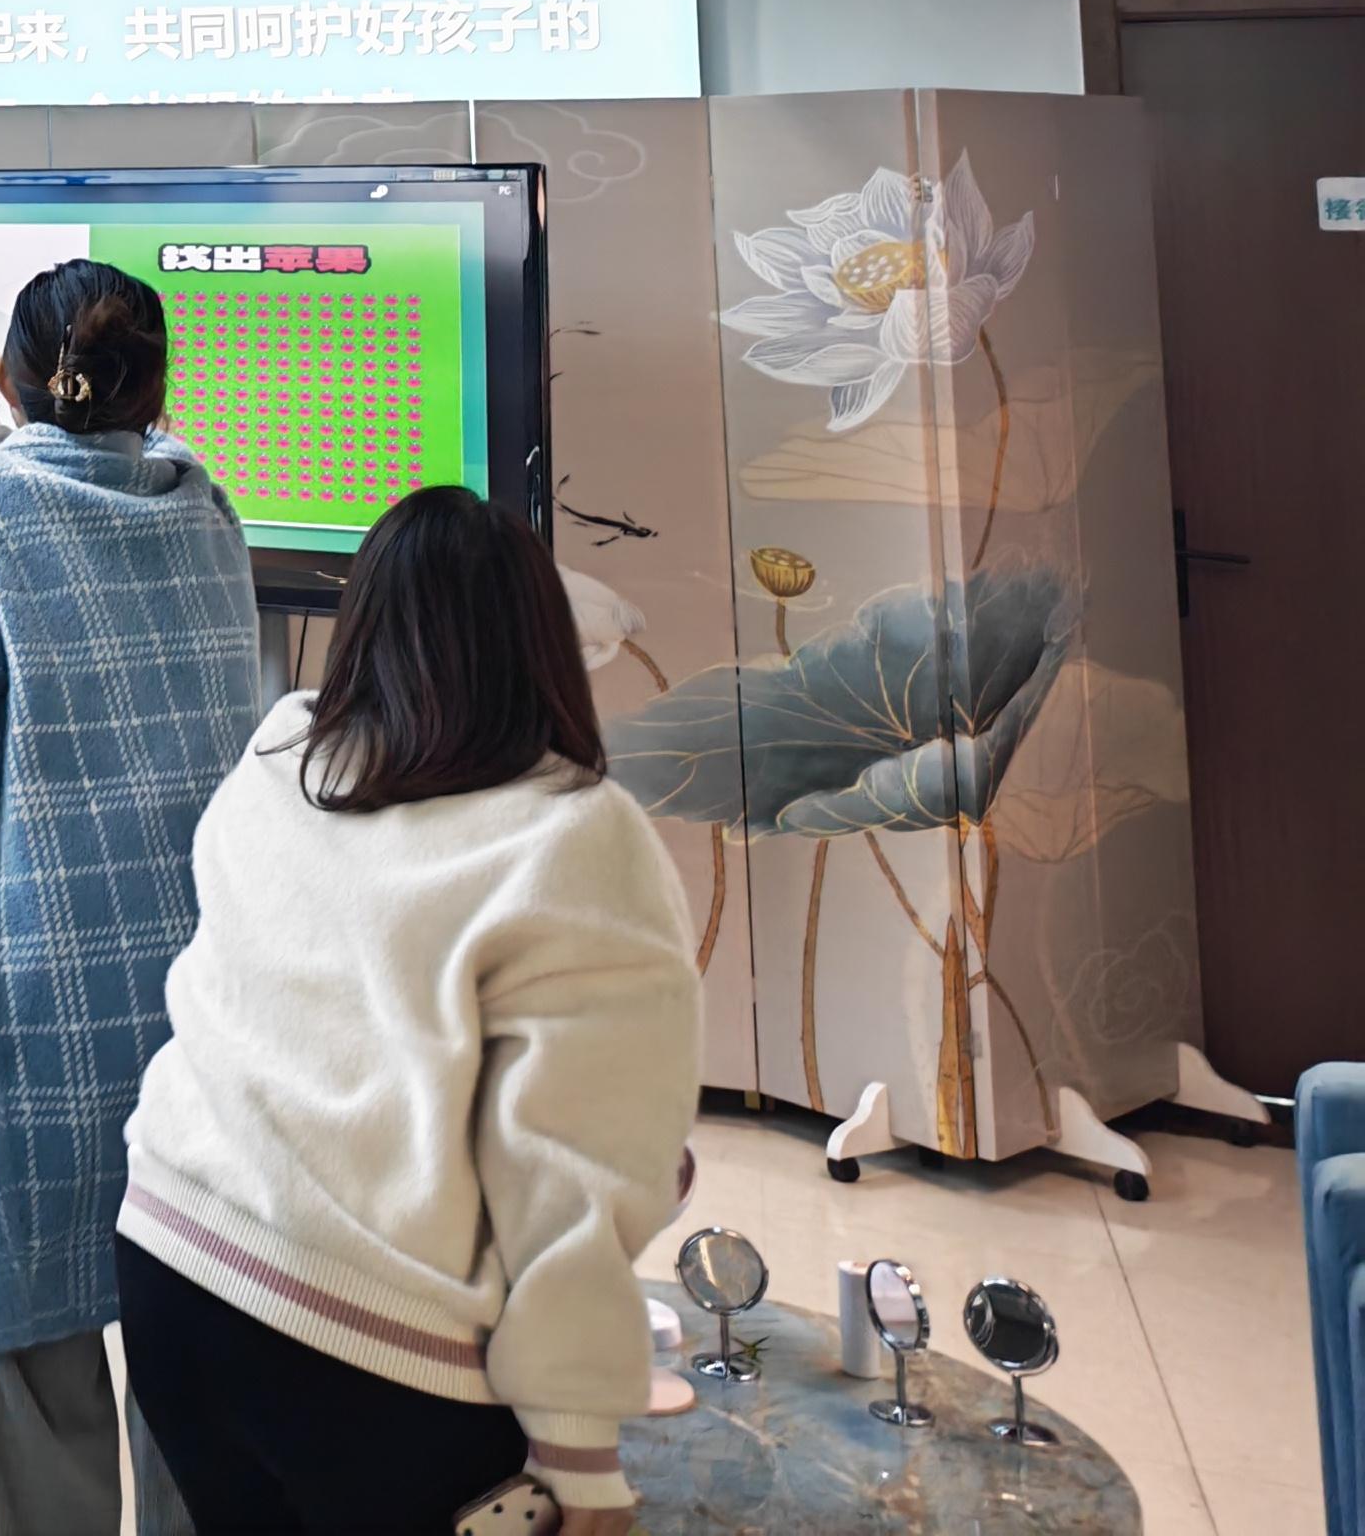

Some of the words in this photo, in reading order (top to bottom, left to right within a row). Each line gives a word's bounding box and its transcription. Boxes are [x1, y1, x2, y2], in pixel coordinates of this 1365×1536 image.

[498, 186, 511, 195] PC
[159, 244, 370, 273] 找出苹果
